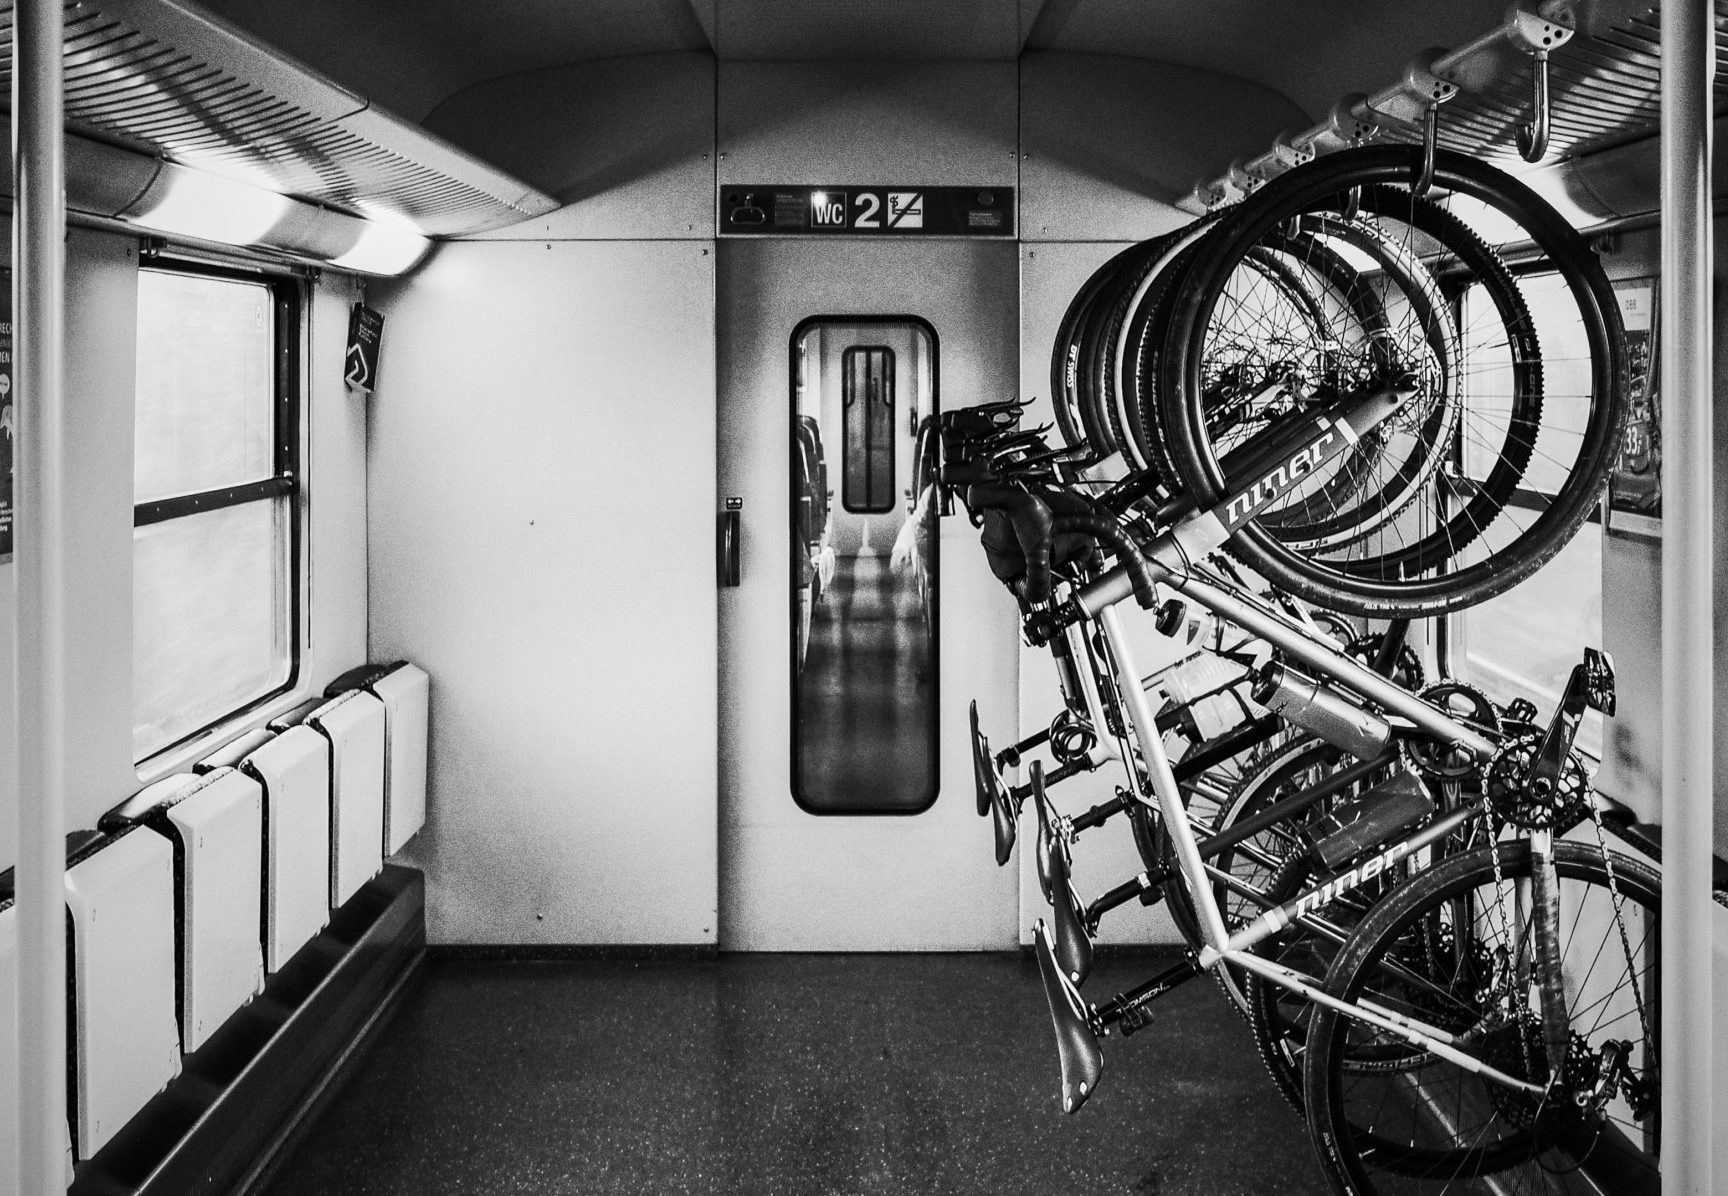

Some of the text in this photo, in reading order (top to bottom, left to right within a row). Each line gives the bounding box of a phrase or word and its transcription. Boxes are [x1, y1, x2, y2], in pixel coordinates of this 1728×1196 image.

[815, 203, 843, 224] WC
[854, 193, 880, 228] 2
[1225, 432, 1334, 525] niner
[1296, 841, 1409, 919] niner
